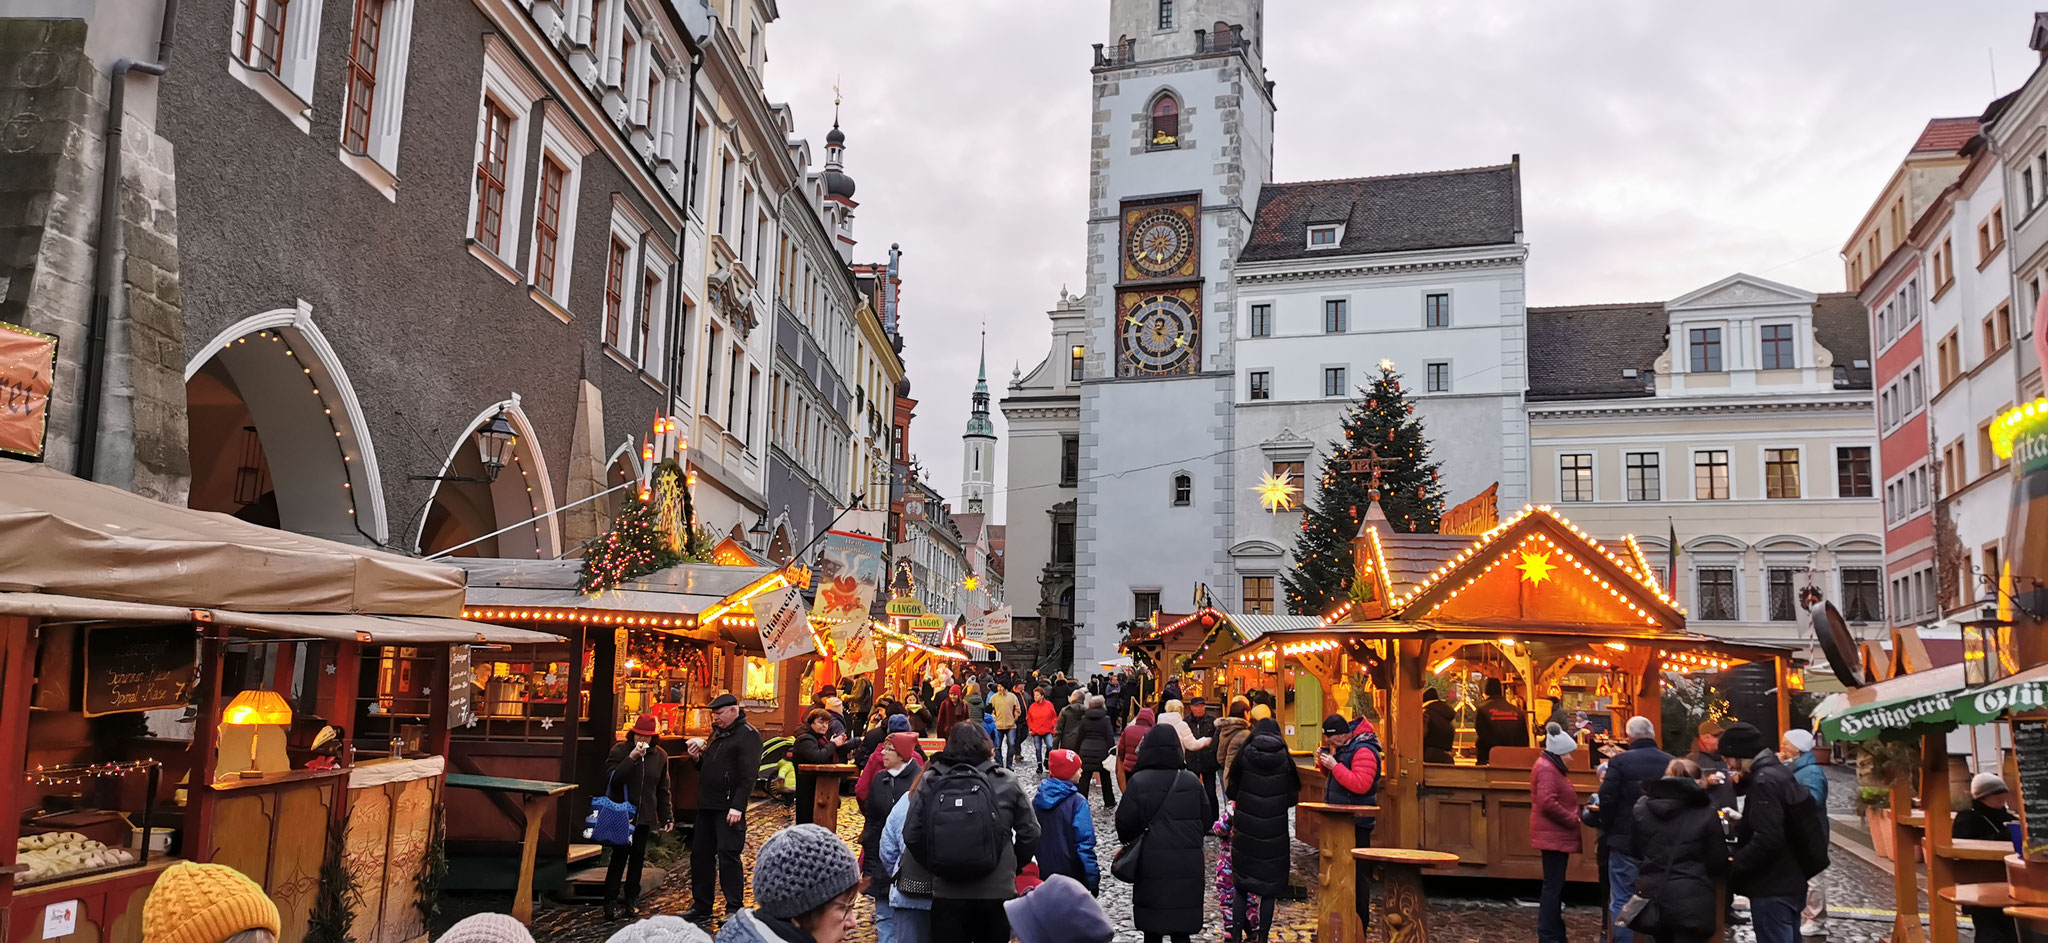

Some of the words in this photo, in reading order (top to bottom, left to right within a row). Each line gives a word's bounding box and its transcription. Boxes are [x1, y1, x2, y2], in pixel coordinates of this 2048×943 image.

[762, 588, 797, 639] Glühwein
[892, 603, 922, 614] LANGOS
[1840, 692, 1955, 737] Heißgeträ
[1974, 682, 2048, 714] Glü
